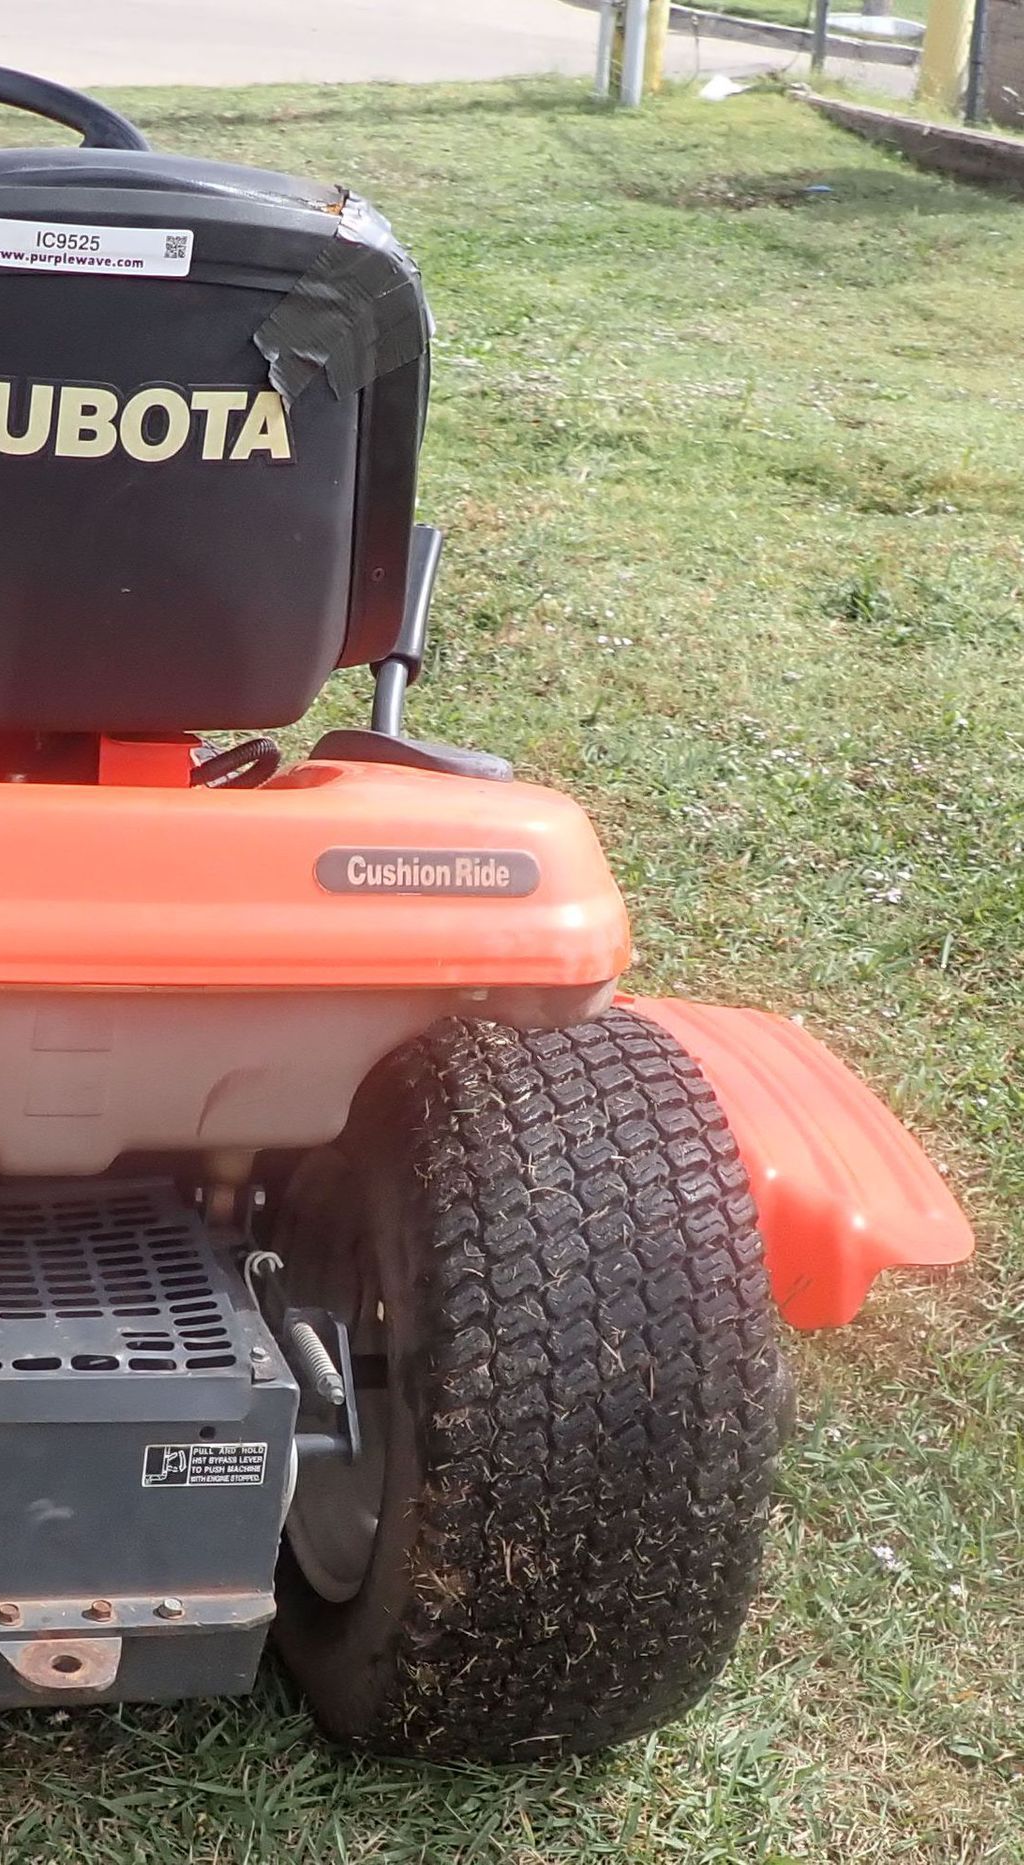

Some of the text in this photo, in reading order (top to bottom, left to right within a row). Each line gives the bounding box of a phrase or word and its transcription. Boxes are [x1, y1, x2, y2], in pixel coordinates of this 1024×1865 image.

[36, 231, 101, 251] IC9525
[347, 855, 510, 887] Cushion Ride
